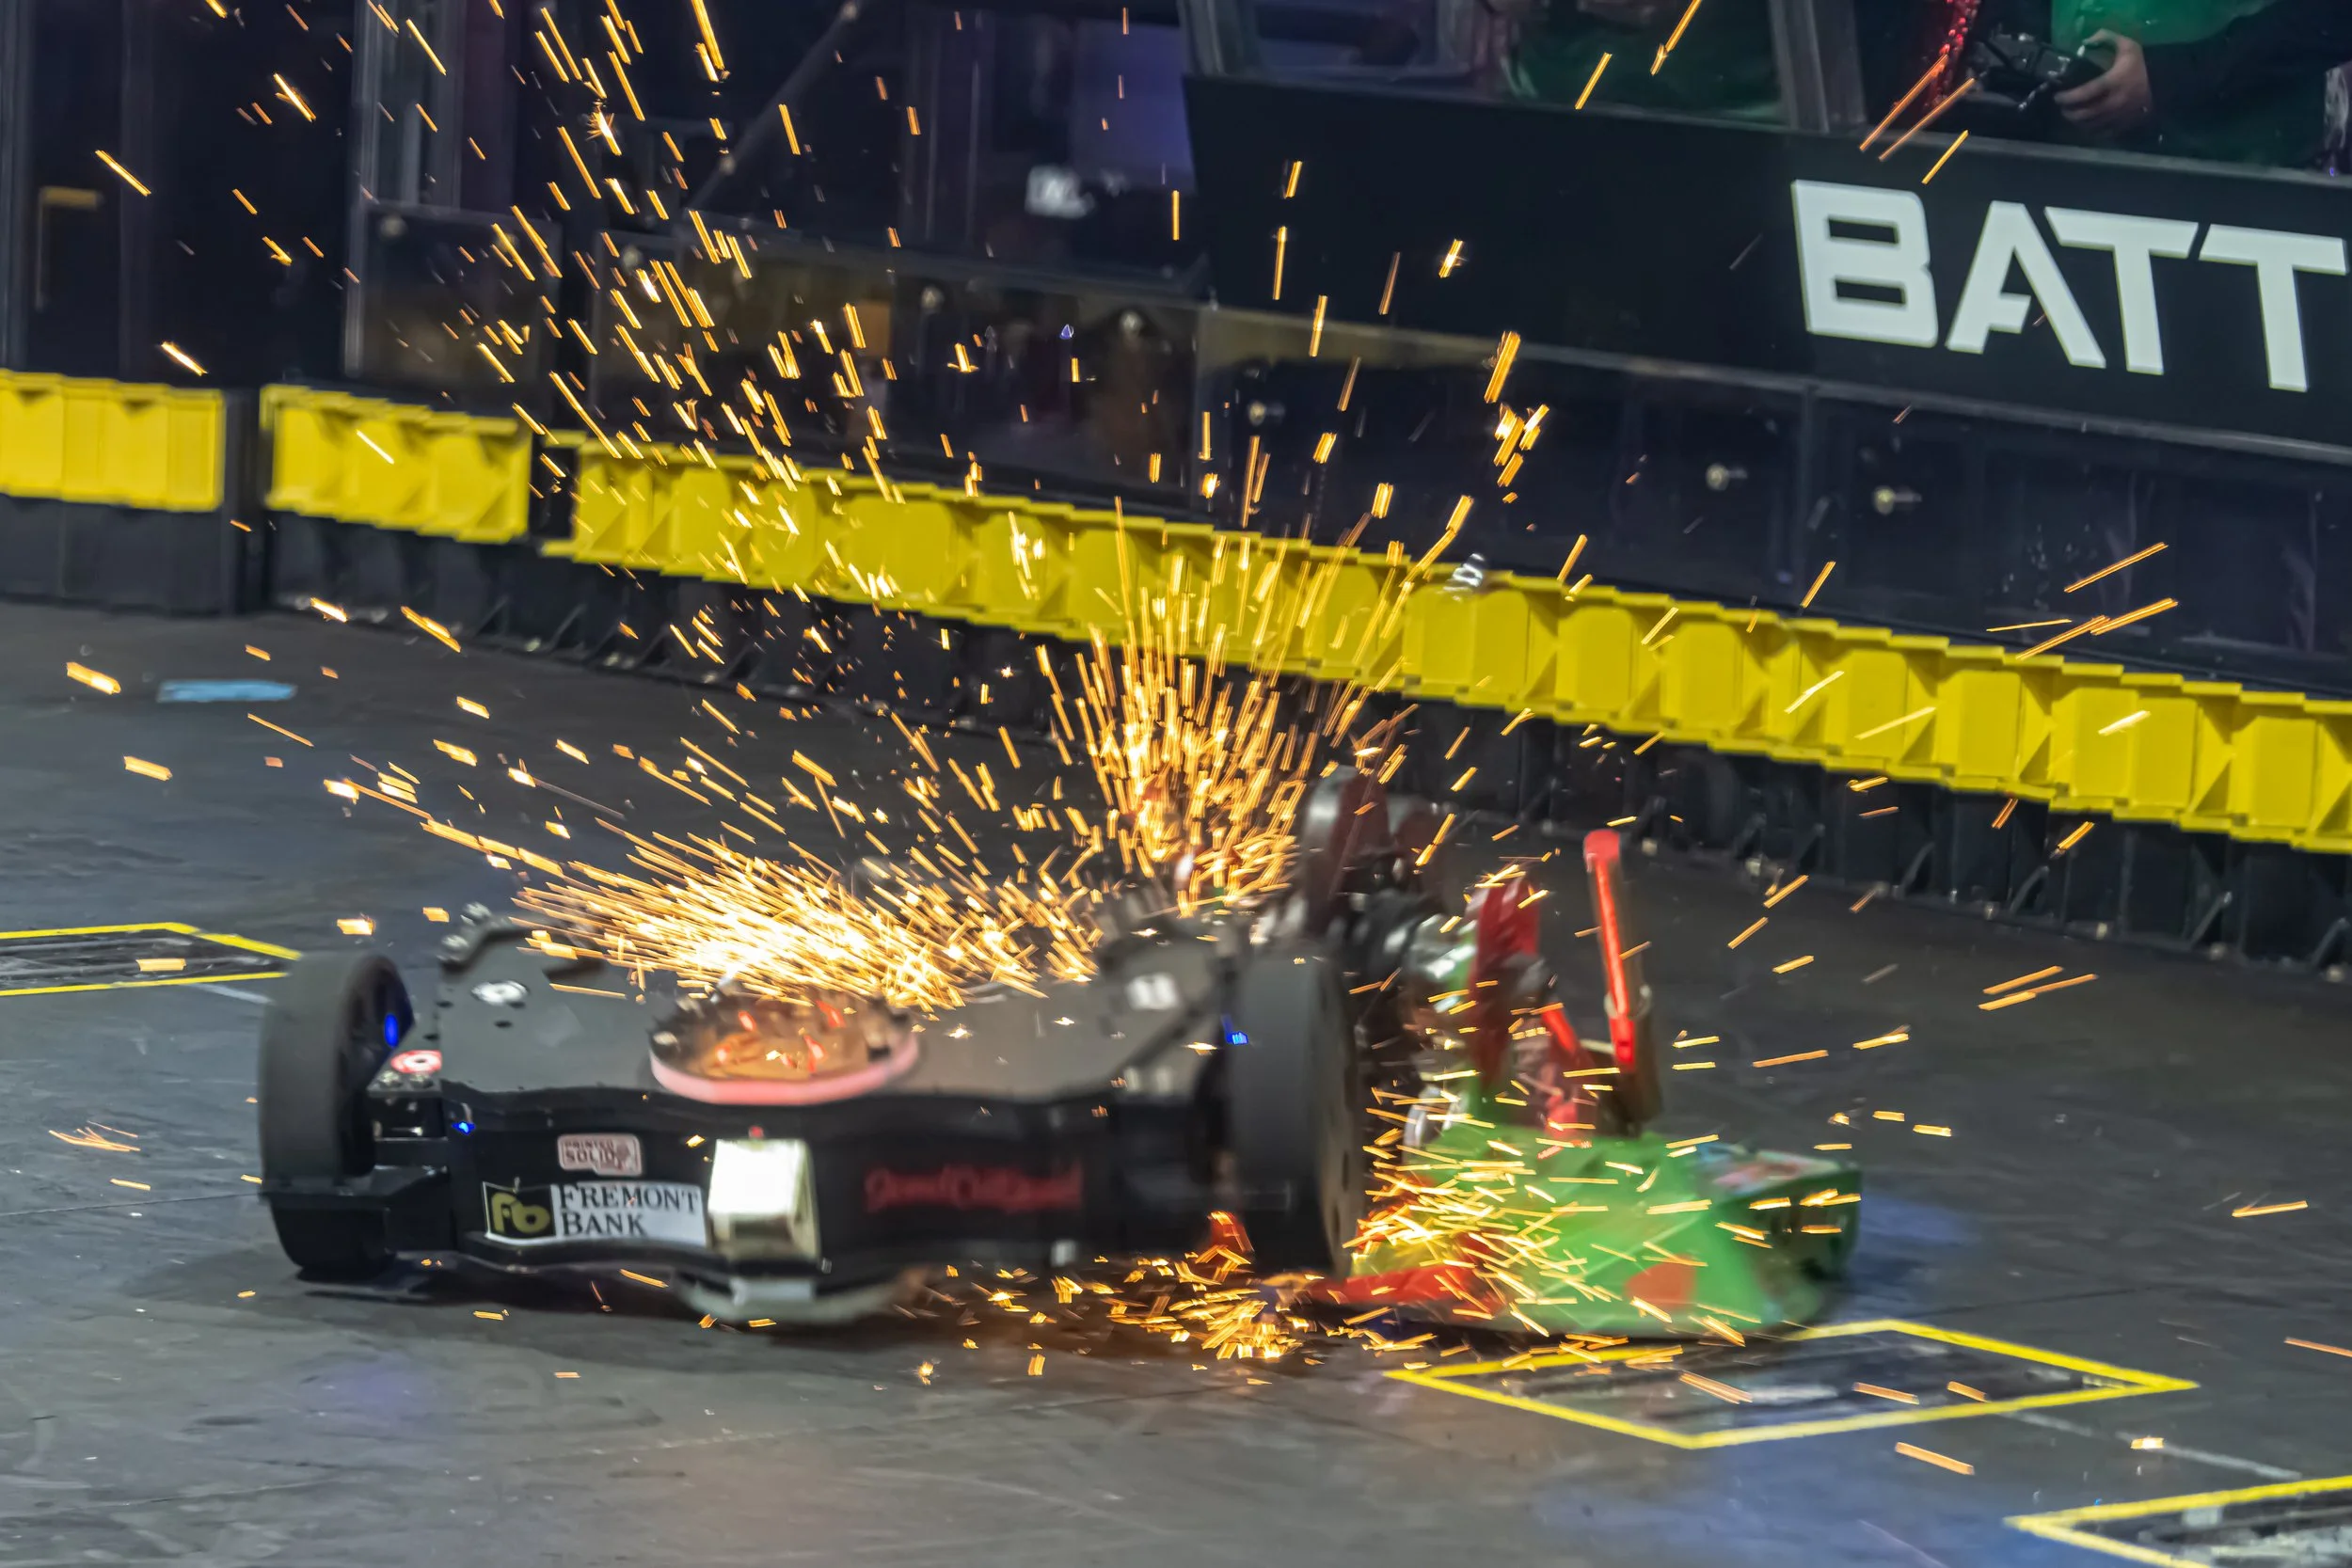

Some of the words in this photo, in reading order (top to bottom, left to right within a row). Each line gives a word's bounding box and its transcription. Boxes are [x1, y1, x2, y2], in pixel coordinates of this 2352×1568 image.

[1790, 179, 2348, 392] BATT
[565, 1148, 615, 1164] SOLID
[559, 1183, 698, 1213] FREMONT
[562, 1212, 647, 1237] BANK
